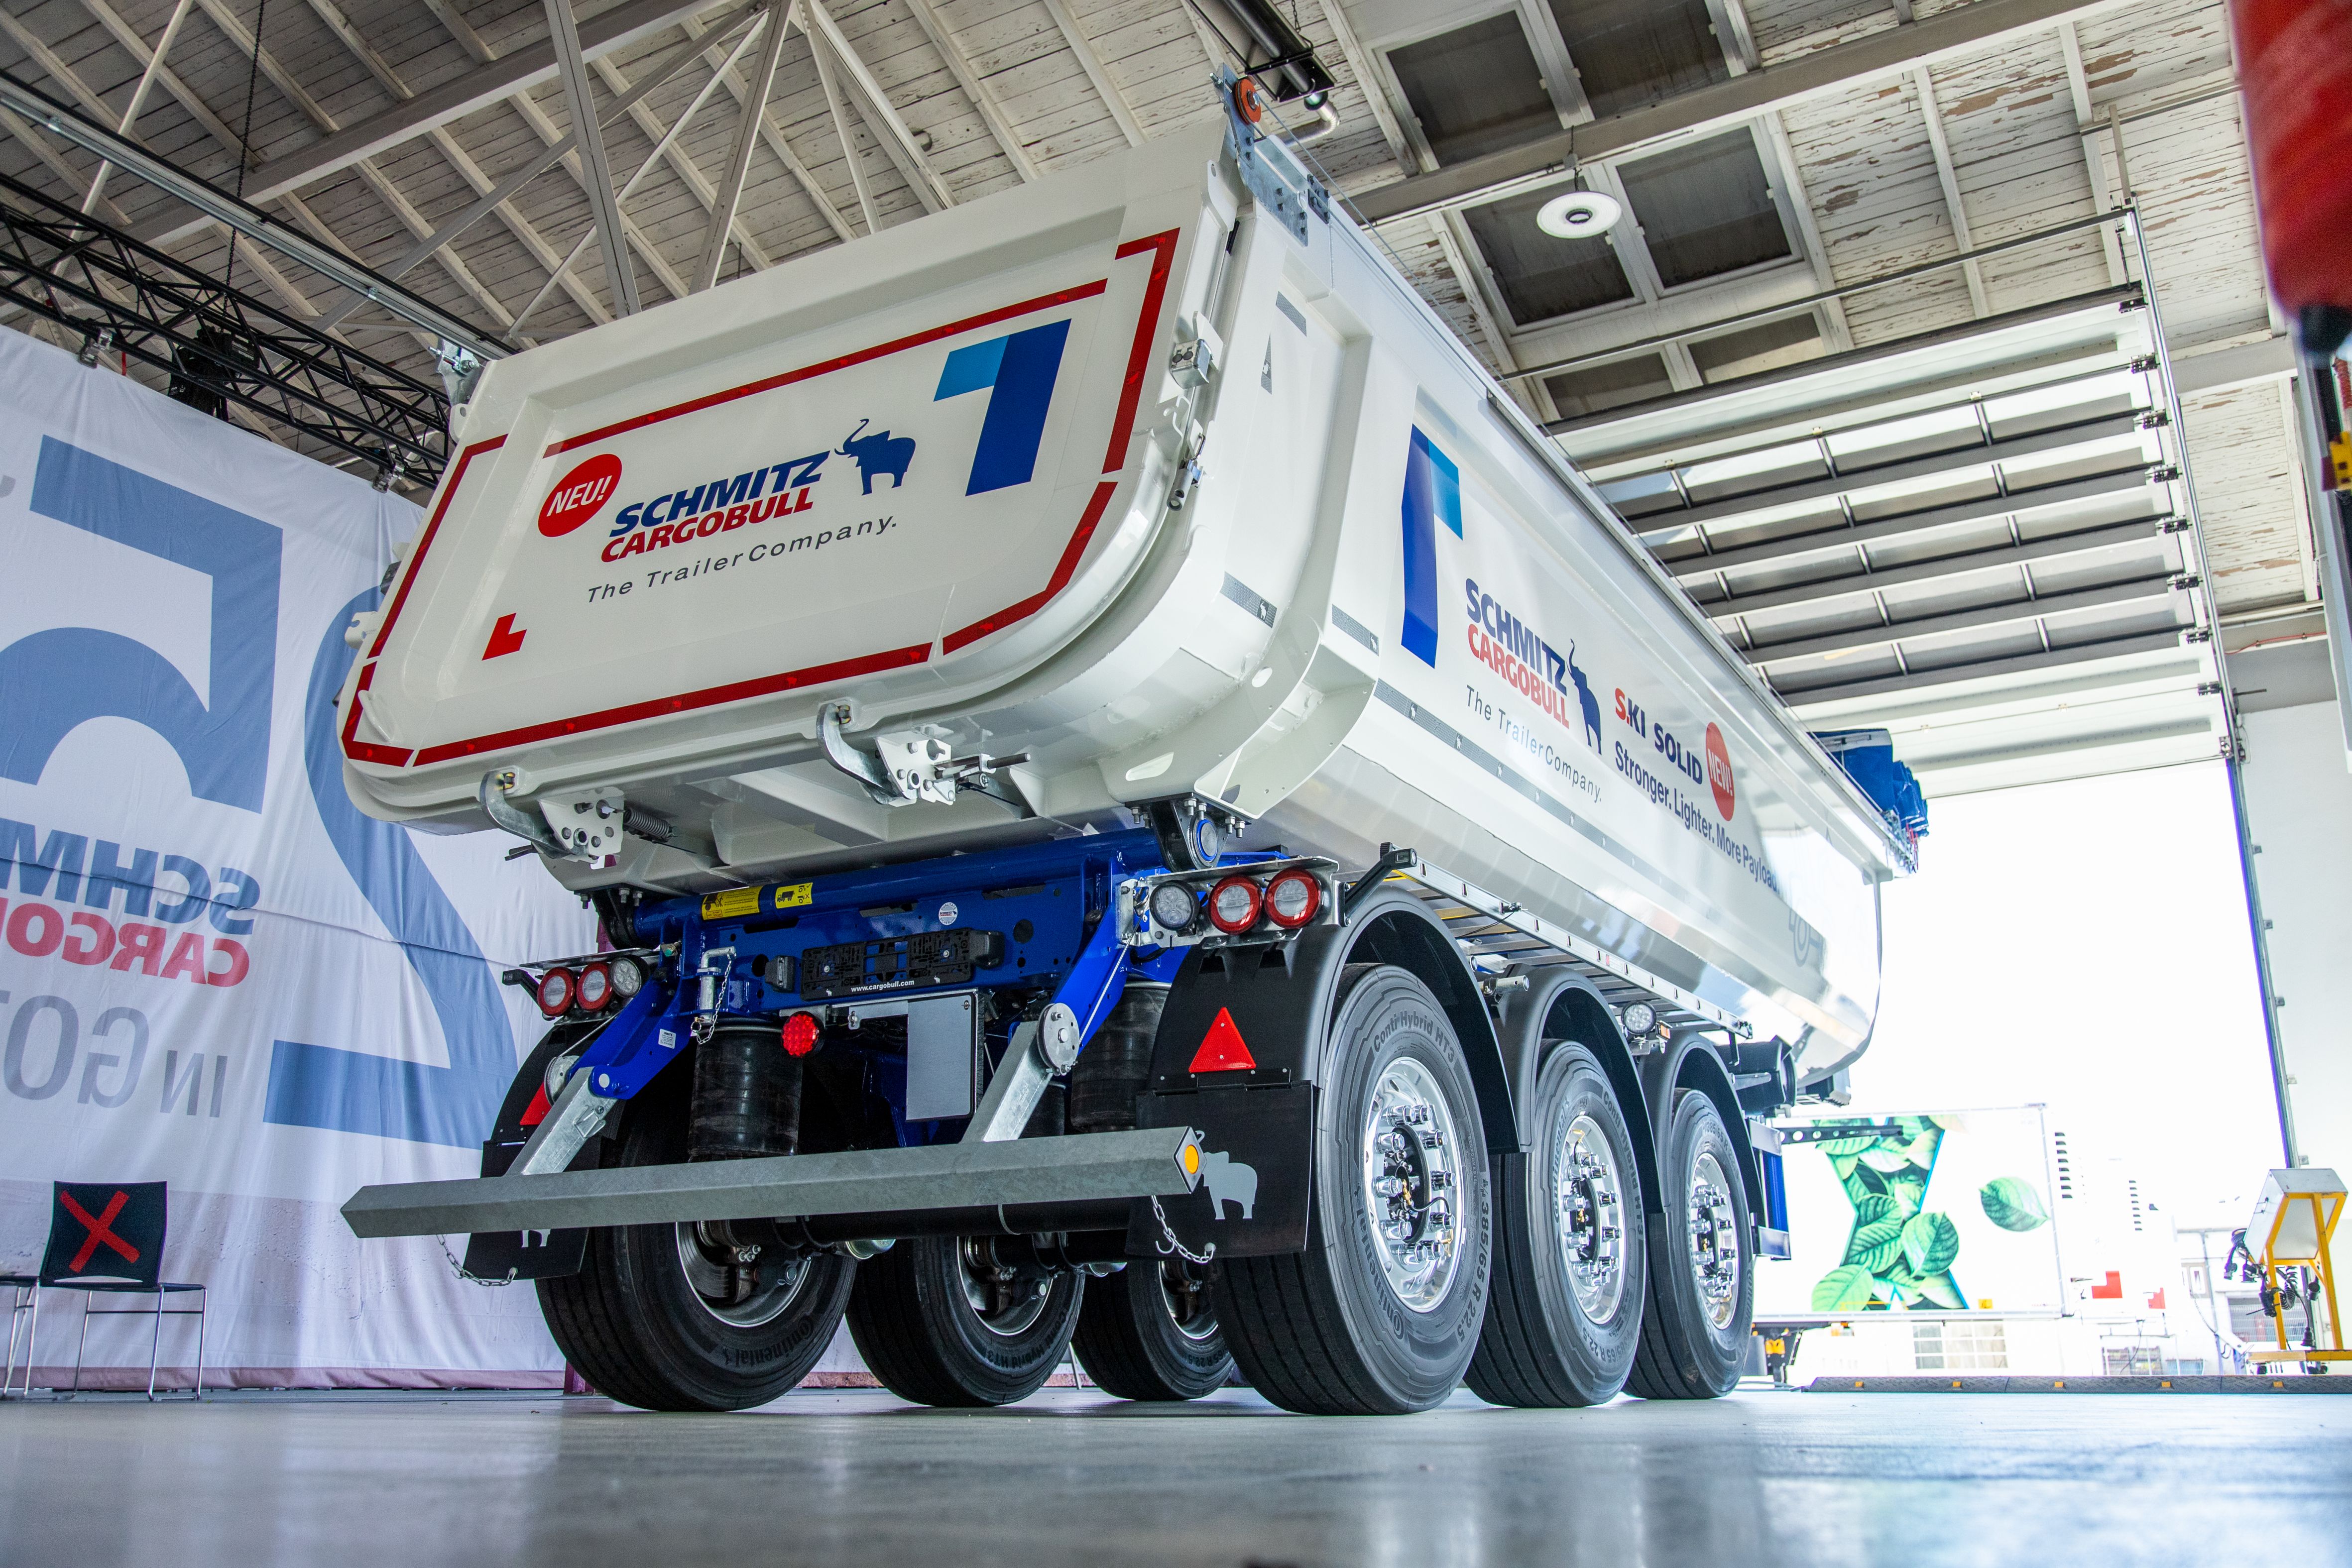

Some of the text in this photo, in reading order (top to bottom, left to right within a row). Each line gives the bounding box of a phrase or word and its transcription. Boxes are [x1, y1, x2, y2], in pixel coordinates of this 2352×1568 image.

[546, 475, 612, 517] NEU!
[600, 486, 815, 563] CARGOBULL
[608, 450, 831, 538] SCHMITZ
[587, 580, 633, 604] The
[1465, 578, 1567, 697] SCHMITZ
[1468, 623, 1570, 729] CARGOBULL
[1466, 684, 1492, 722] The
[1615, 687, 1703, 785] S.KI SOLID
[1707, 748, 1733, 797] NEW!
[1615, 740, 1780, 894] Stronger. Lighter. More Payload.
[851, 980, 915, 992] www.cargobull.com
[1400, 1010, 1433, 1036] Hybrid
[1435, 1026, 1455, 1063] HT3
[1356, 1207, 1405, 1341] Continental
[1457, 1201, 1489, 1343] 385/65 R 22.5
